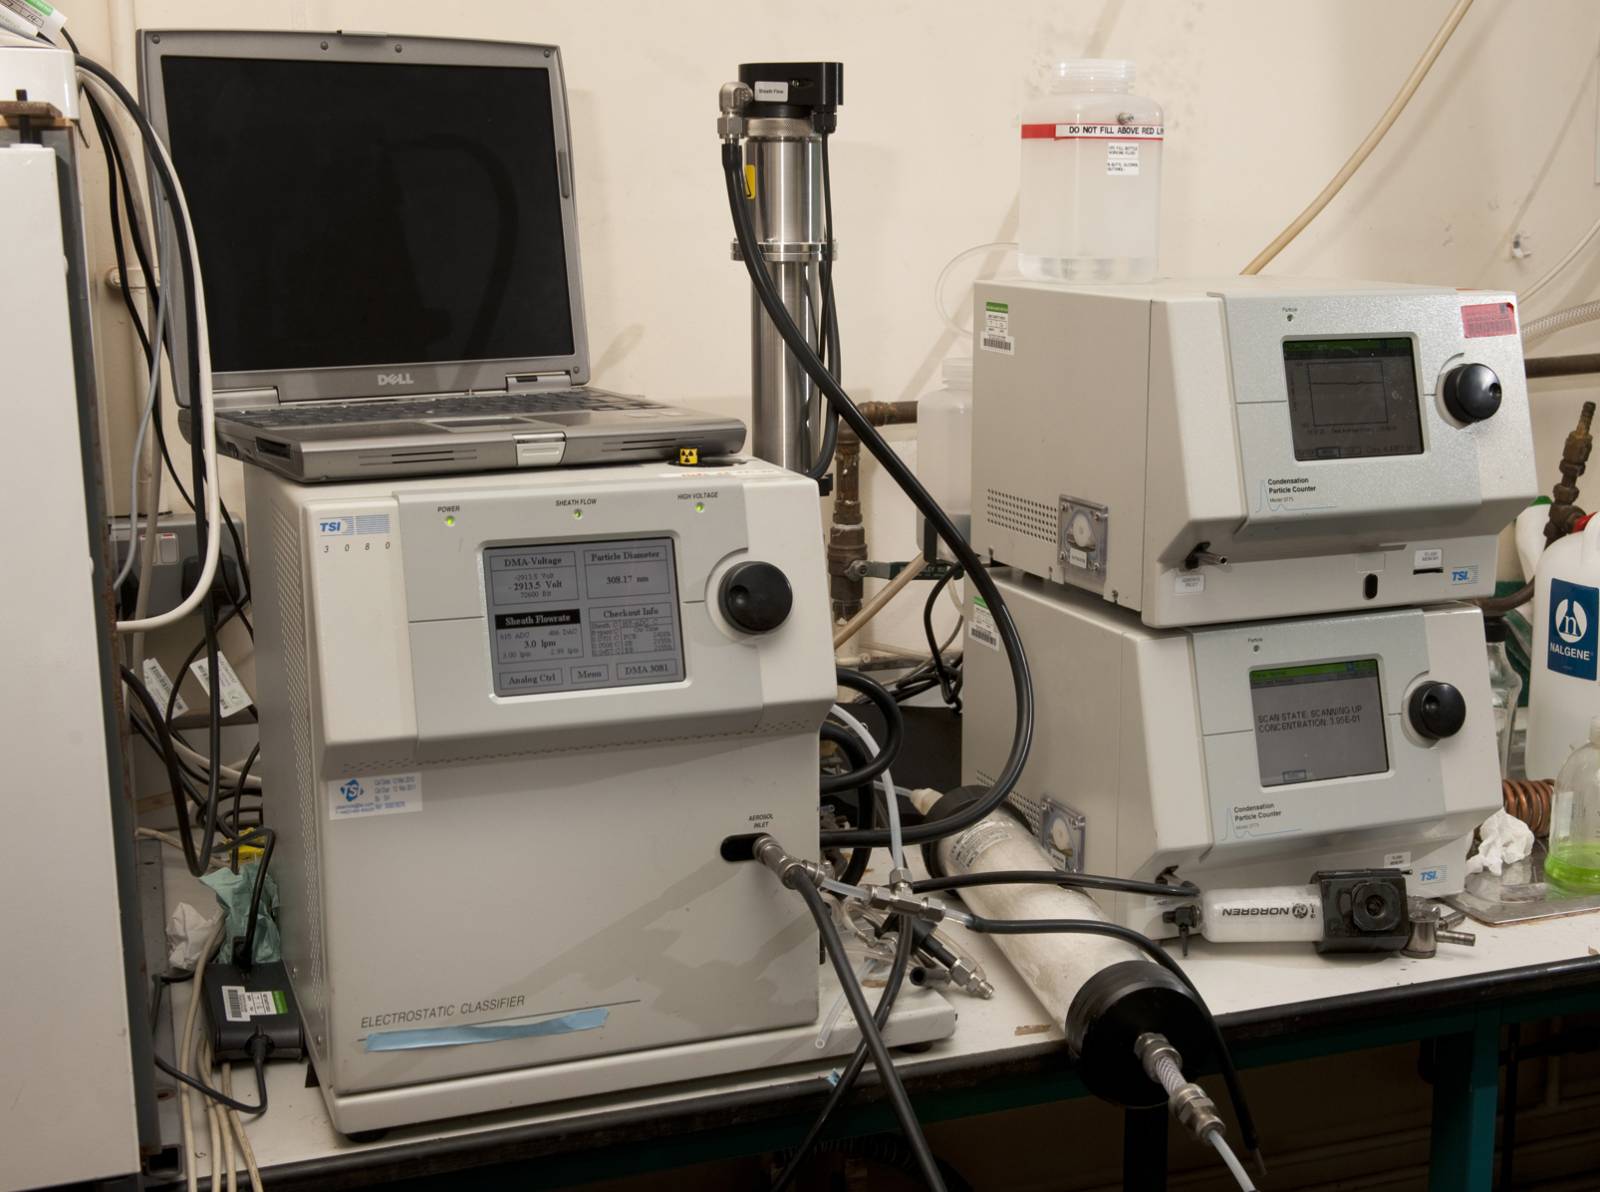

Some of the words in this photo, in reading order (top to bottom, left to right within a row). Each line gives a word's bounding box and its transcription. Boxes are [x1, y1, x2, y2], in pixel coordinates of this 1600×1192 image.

[1069, 126, 1080, 134] DO
[1082, 126, 1098, 134] NOT
[1100, 126, 1114, 134] FILL
[1142, 127, 1154, 135] RED
[377, 373, 415, 386] DELL
[1267, 477, 1309, 486] Condensation
[692, 491, 718, 499] VOLTAGE
[556, 499, 579, 507] SHEATH
[437, 505, 460, 513] POWER
[320, 521, 341, 532] TSI
[591, 552, 621, 562] Particle
[623, 550, 660, 560] Diameter
[504, 558, 528, 567] DMA
[531, 556, 562, 566] Voltage
[1451, 570, 1468, 581] TSI
[545, 580, 562, 589] Volt
[603, 608, 641, 618] Checkout
[642, 607, 659, 616] Info
[505, 616, 534, 626] Sheath
[535, 614, 571, 624] Flowrate
[1550, 641, 1591, 660] NALGENE
[626, 666, 648, 675] DMA
[509, 675, 538, 685] Analog
[539, 674, 556, 683] Ctrl
[1351, 704, 1362, 714] UP
[1233, 803, 1274, 813] Condensation
[1420, 871, 1437, 881] TSI
[1222, 906, 1289, 916] NORGREN
[360, 1004, 455, 1029] ELECTROSTATIC
[460, 995, 525, 1015] CLASSIFIER
